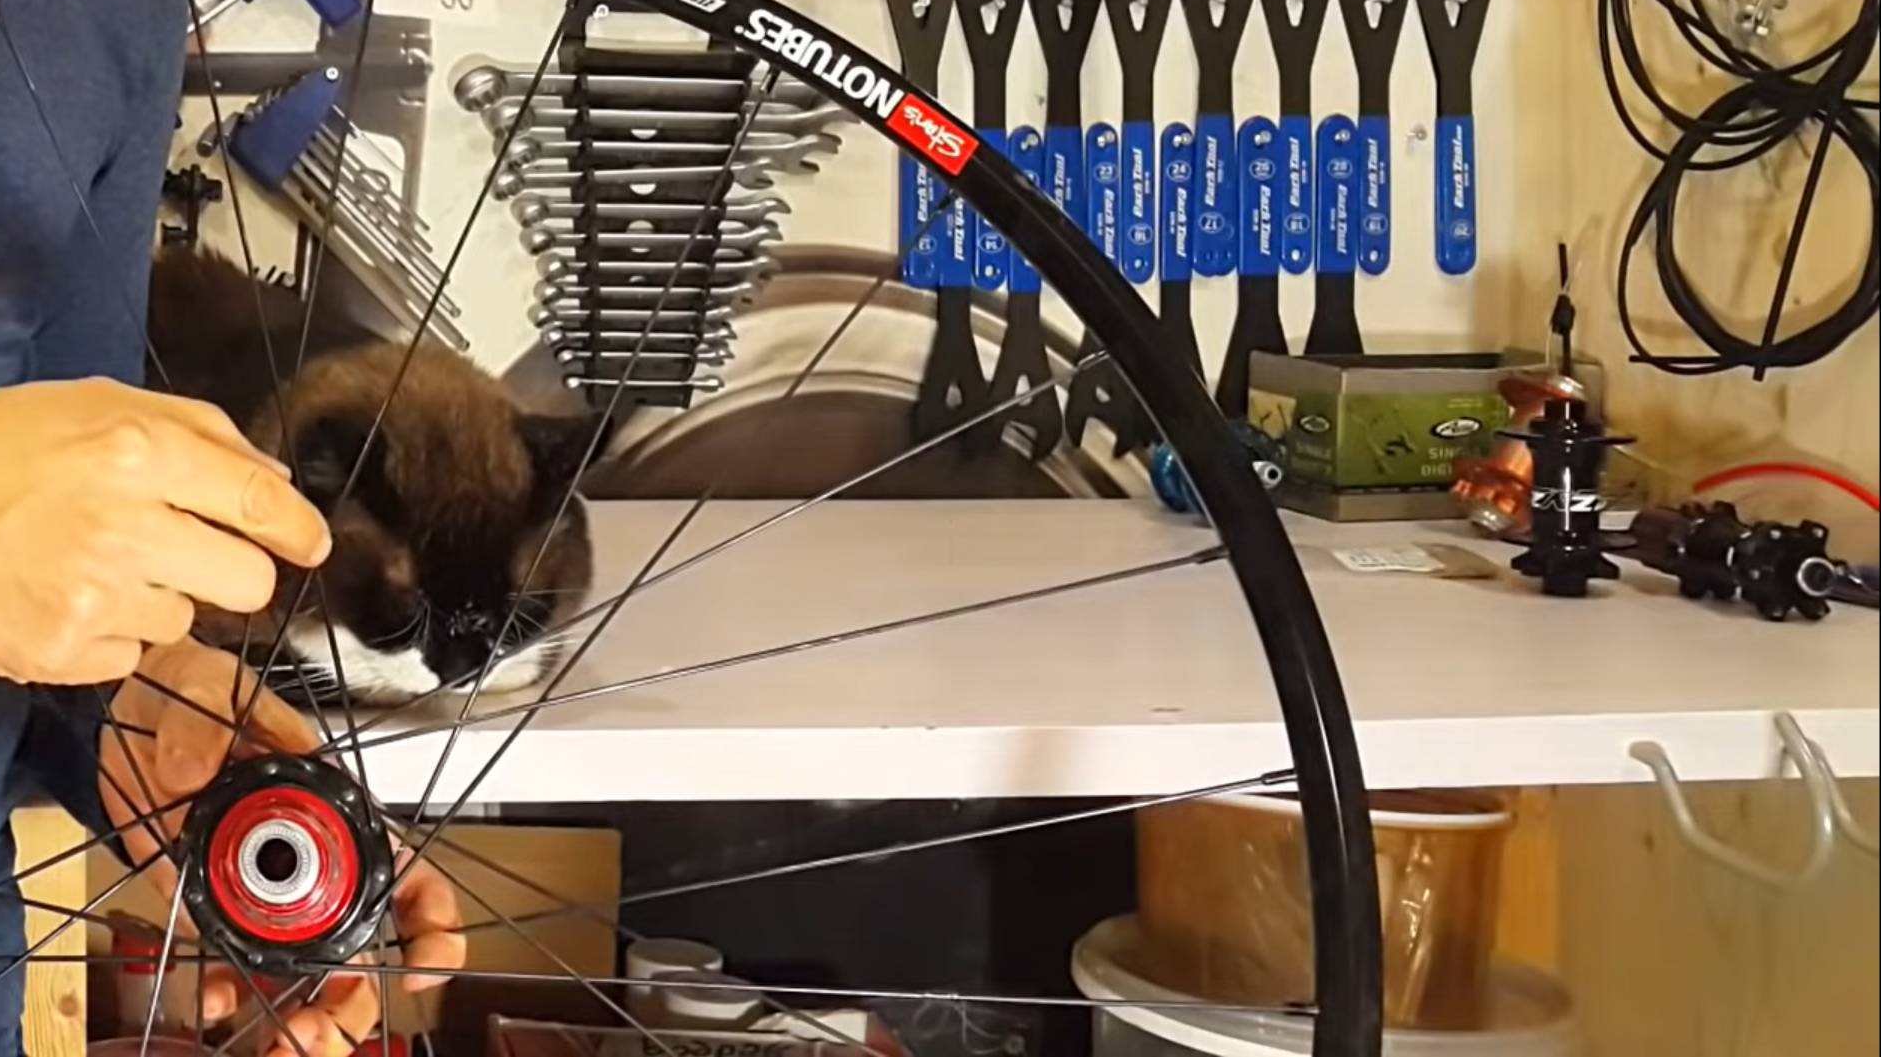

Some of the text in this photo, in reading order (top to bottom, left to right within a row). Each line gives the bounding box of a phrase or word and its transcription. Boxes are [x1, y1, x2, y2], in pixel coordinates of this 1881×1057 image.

[902, 105, 965, 157] Stan's
[1428, 447, 1456, 460] SIN
[1421, 465, 1453, 477] DIGI
